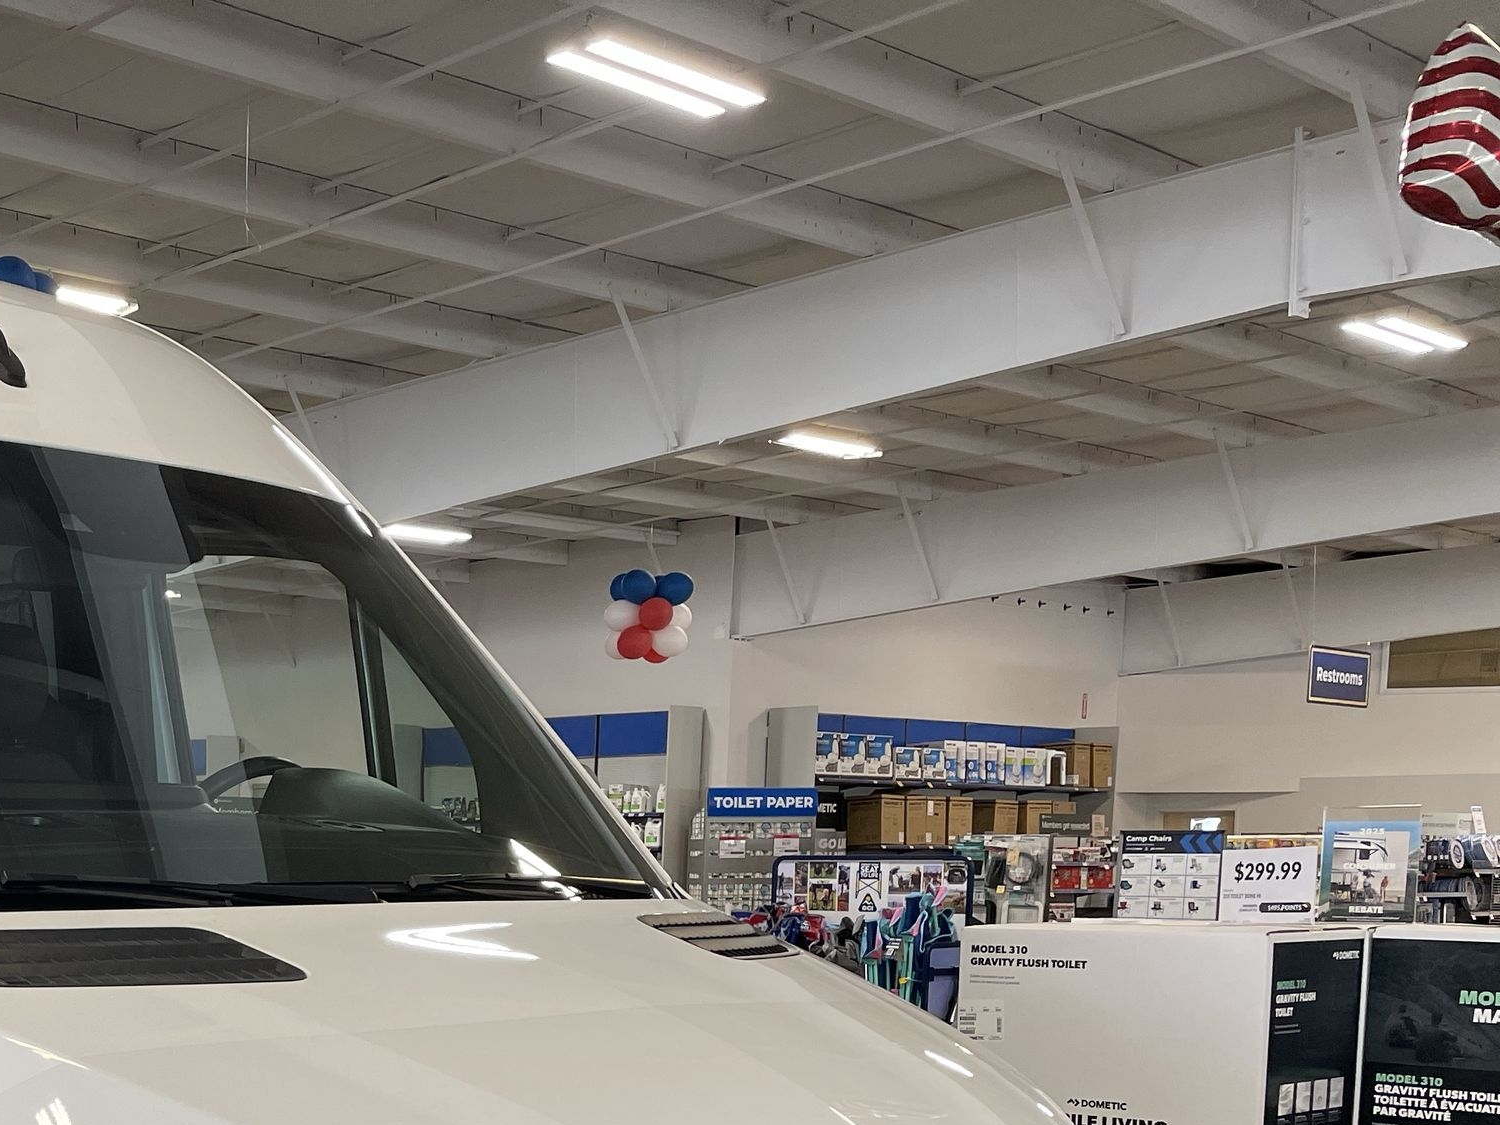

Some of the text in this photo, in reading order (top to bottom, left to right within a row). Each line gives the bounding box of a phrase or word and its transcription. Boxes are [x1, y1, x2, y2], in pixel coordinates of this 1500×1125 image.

[1316, 666, 1363, 686] Restrooms
[714, 796, 814, 809] TOILET PAPER
[1126, 834, 1172, 843] Camp Chairs
[860, 865, 880, 873] SEAT
[1234, 861, 1302, 883] $299.99
[1348, 905, 1384, 914] REBATE
[971, 945, 1028, 954] MODEL 310
[970, 957, 1088, 969] GRAVITY FLUSH TOILET
[1276, 993, 1299, 1004] GRAVITY
[1275, 1007, 1294, 1017] TOILET
[1375, 1073, 1443, 1087] MODEL 310
[1374, 1084, 1428, 1098] GRAVITY
[1429, 1089, 1469, 1101] FLUSH
[1081, 1099, 1127, 1111] DOMETIC
[1374, 1094, 1428, 1109] TOILETTE
[1429, 1097, 1439, 1110] À
[1373, 1105, 1452, 1122] PAR GRAVITÉ
